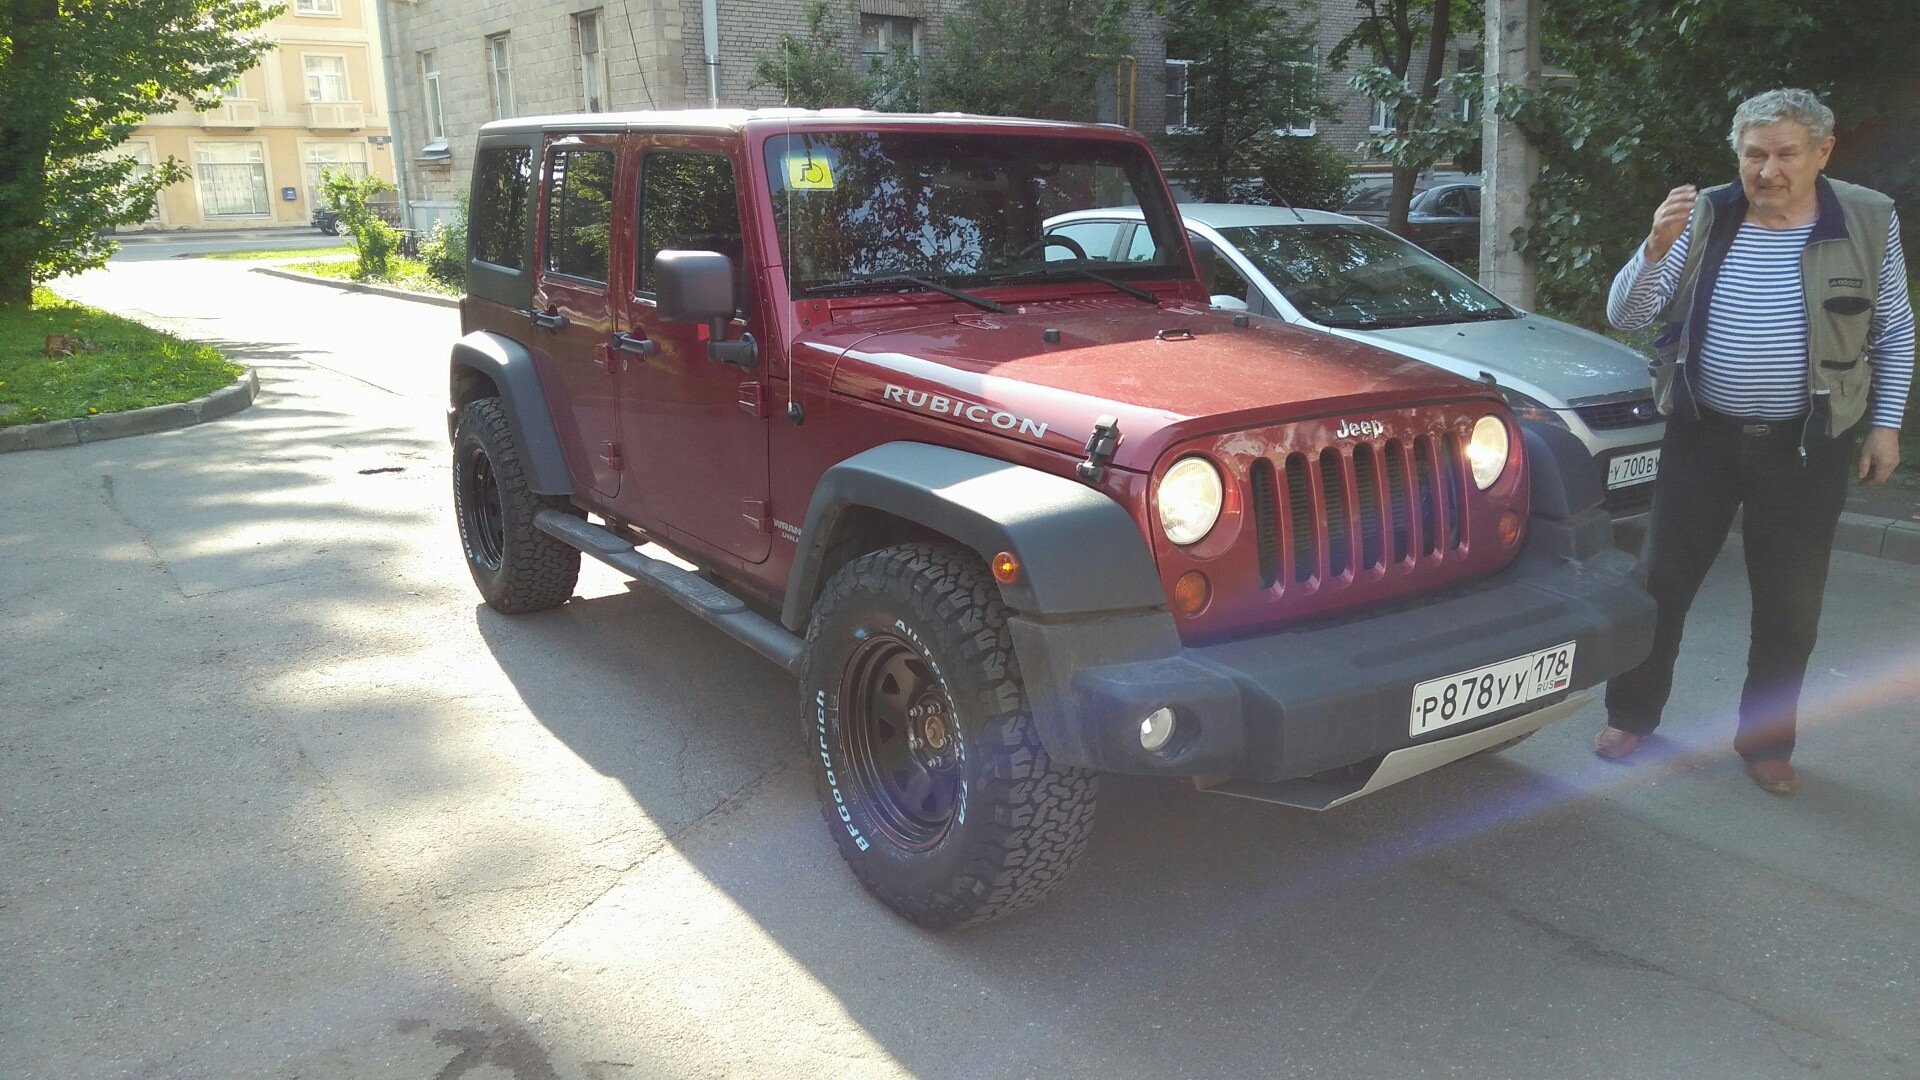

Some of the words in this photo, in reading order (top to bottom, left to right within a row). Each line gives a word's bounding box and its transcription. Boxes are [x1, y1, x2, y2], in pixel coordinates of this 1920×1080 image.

[883, 384, 1049, 439] RUBICON
[1336, 419, 1384, 439] Jeep
[1534, 650, 1568, 683] 178
[1536, 678, 1554, 694] RUS
[816, 690, 869, 851] BFGoodrich
